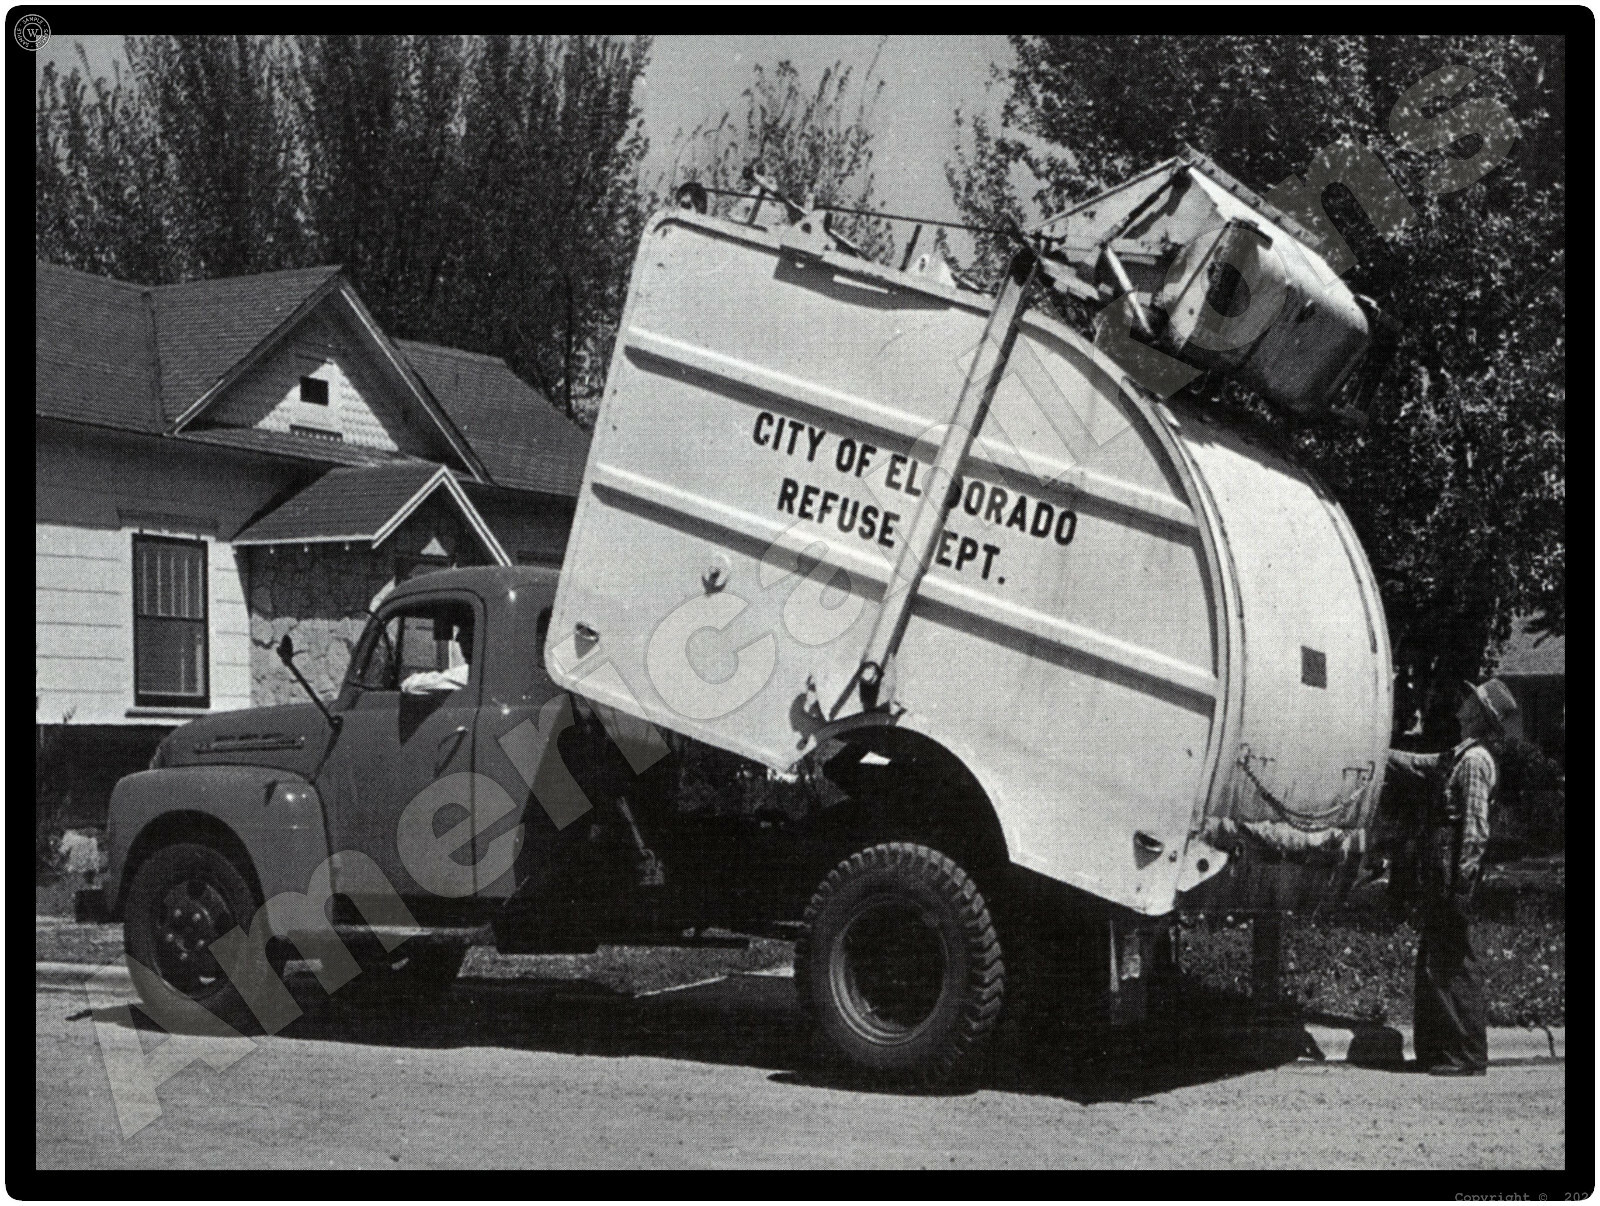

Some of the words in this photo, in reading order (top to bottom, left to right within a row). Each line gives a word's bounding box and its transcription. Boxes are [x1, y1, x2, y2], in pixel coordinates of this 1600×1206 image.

[752, 411, 826, 462] CITY
[835, 438, 877, 477] OF
[885, 453, 922, 497] EL
[776, 477, 901, 549] REFUSE
[935, 529, 1006, 586] EPT.
